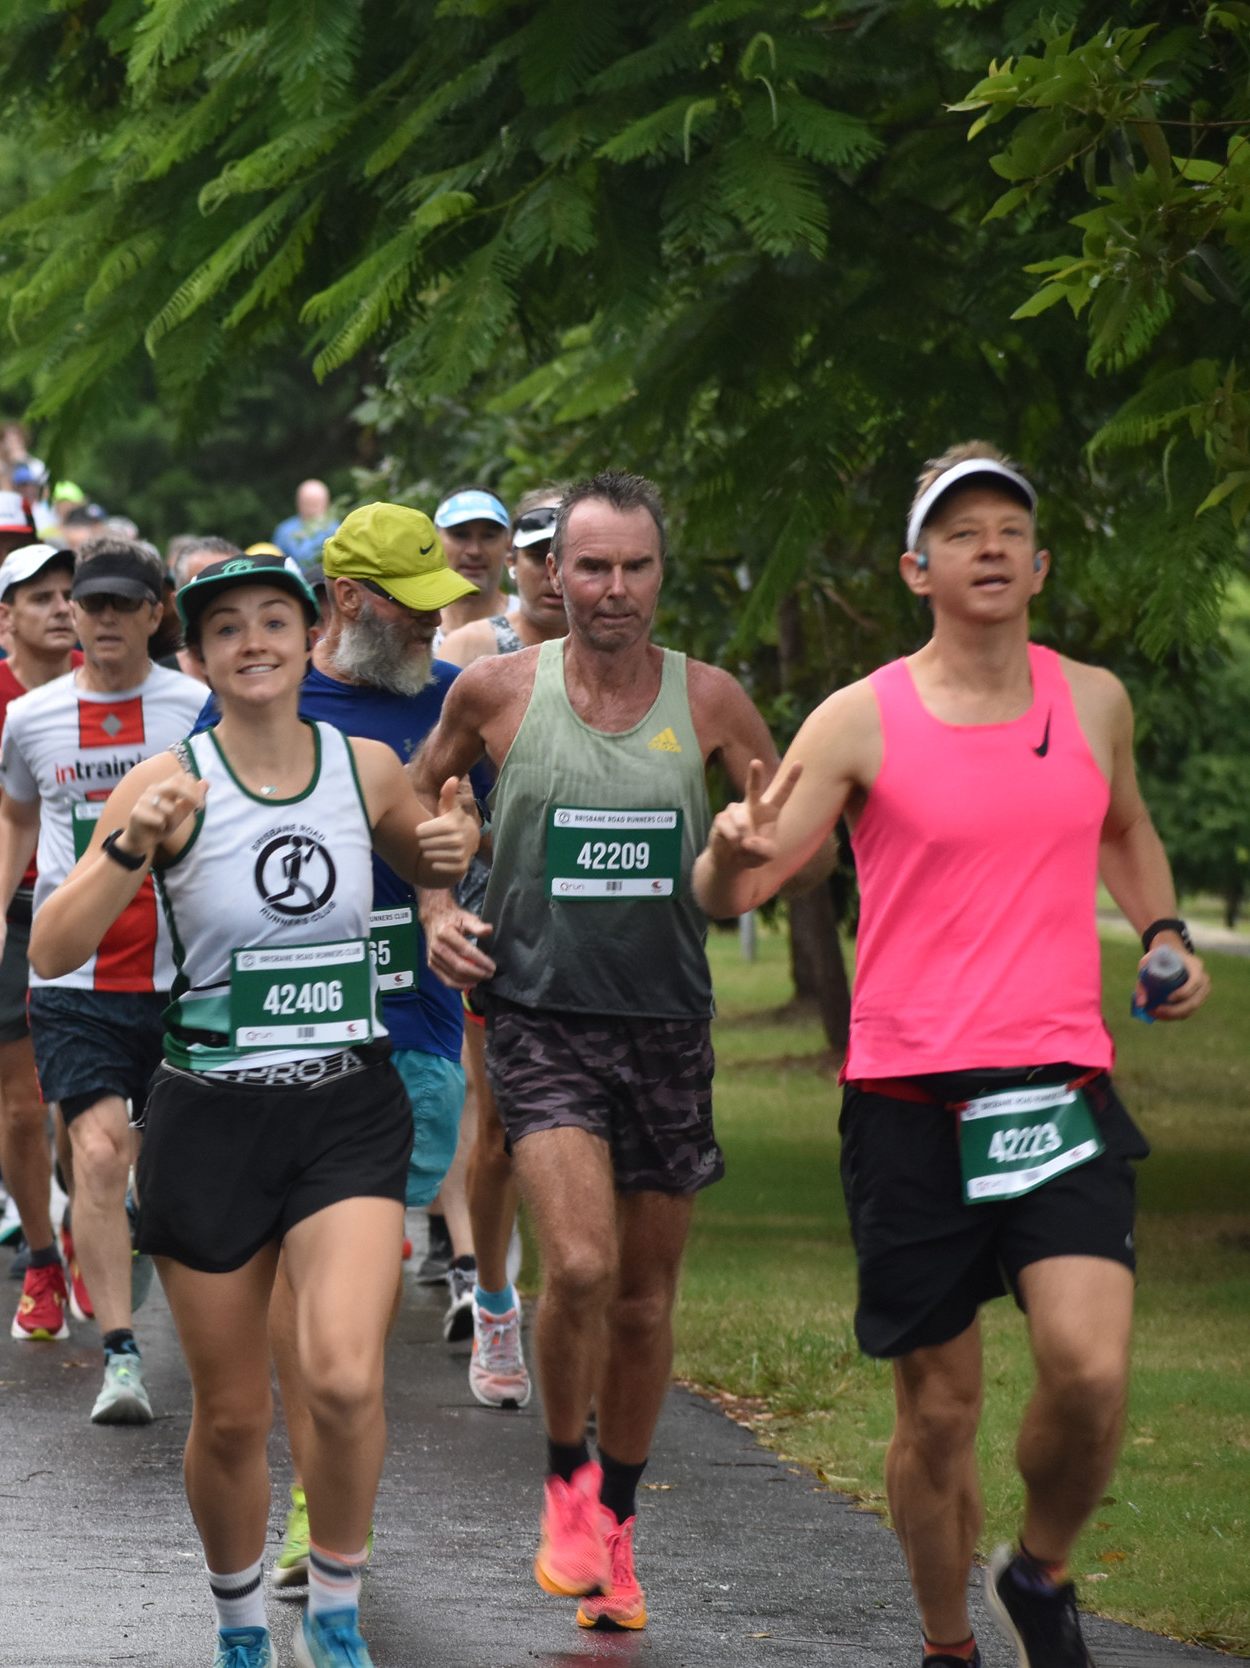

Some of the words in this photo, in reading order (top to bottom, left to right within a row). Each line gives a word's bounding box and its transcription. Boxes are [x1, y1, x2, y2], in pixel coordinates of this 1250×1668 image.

[575, 814, 605, 824] BRISBANE
[607, 815, 625, 824] ROAD
[626, 816, 655, 825] RUNNERS
[657, 816, 673, 824] CLUB
[577, 842, 650, 870] 42209
[368, 914, 393, 922] UNNERS
[263, 980, 344, 1015] 42406
[988, 1122, 1063, 1163] 42223
